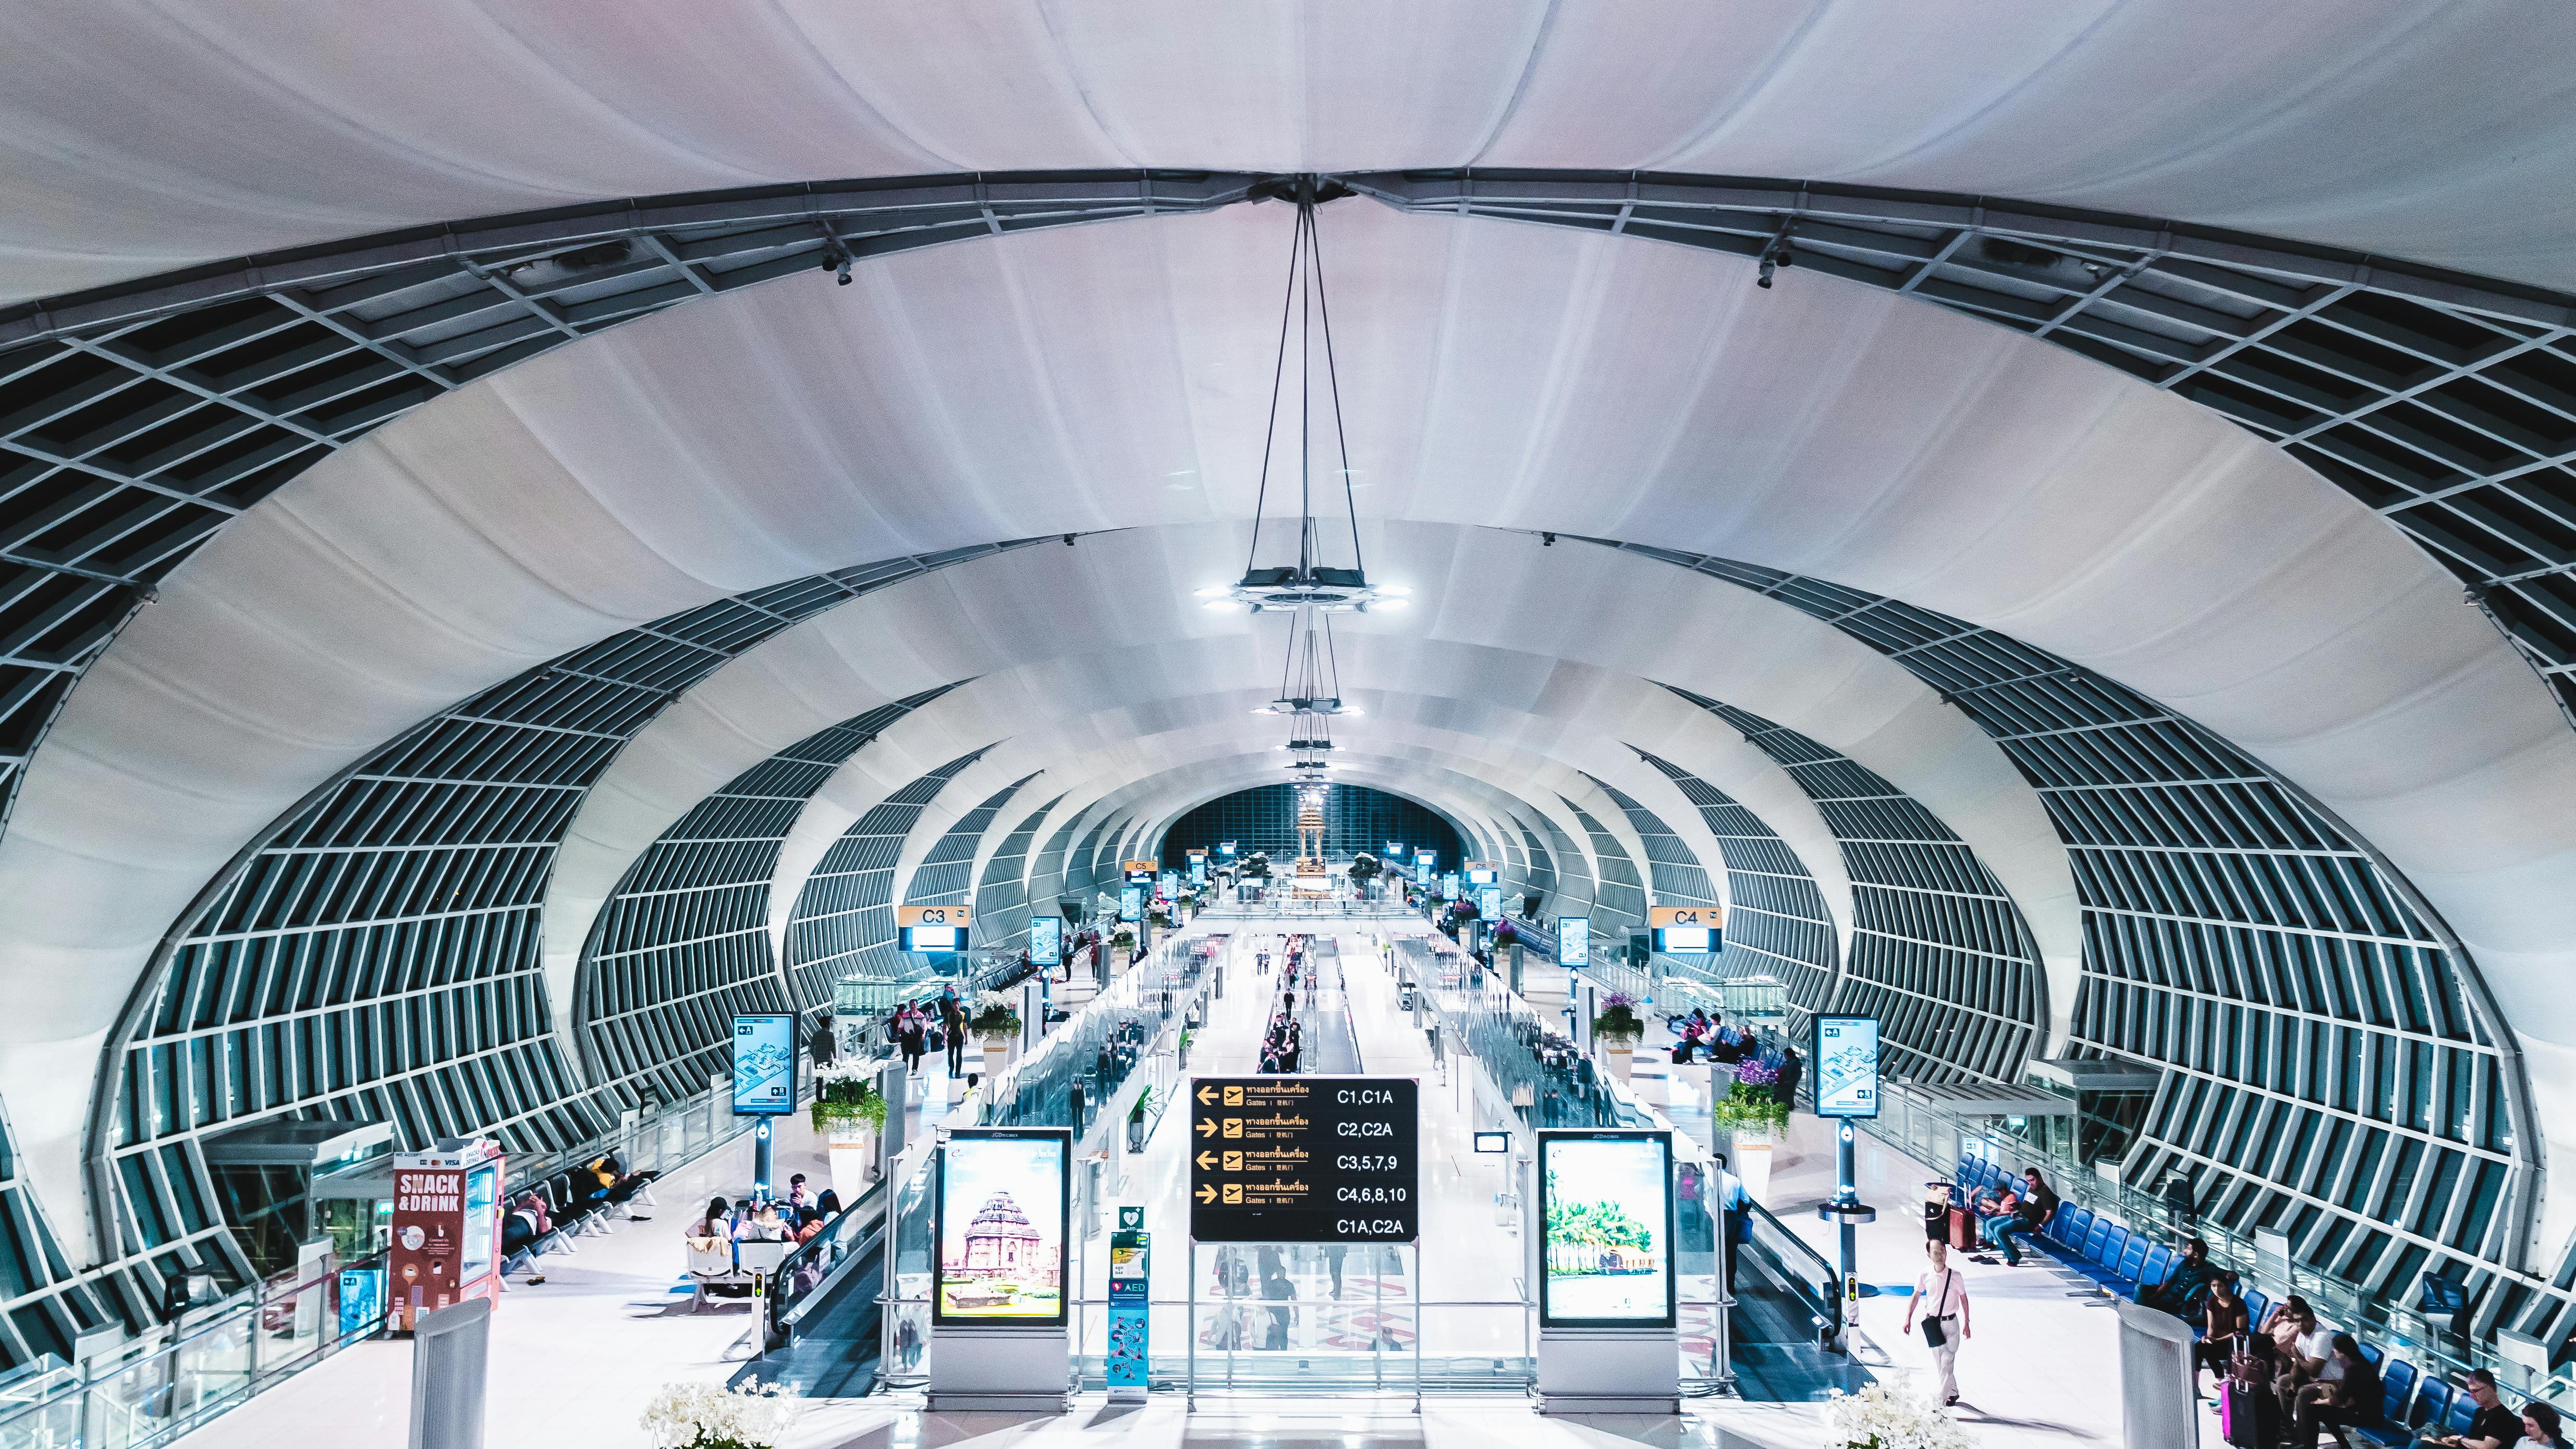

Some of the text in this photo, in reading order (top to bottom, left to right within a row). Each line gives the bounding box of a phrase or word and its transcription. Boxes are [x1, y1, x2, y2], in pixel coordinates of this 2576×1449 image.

[923, 909, 945, 923] C3
[1675, 911, 1698, 924] C4
[1246, 1080, 1309, 1093] ทางออกขึ้นเครื่อง
[1337, 1090, 1393, 1106] C1,C1A
[1246, 1112, 1309, 1125] ทางออกขึ้นเครื่อง
[1337, 1123, 1393, 1138] C2,C2A
[1246, 1145, 1309, 1158] ทางออกขึ้นเครื่อง
[1337, 1156, 1397, 1171] C3,5,7,9
[400, 1174, 459, 1194] SNACK
[1246, 1178, 1309, 1191] ทางออกขึ้นเครื่อง
[398, 1195, 459, 1212] &DRINK
[1337, 1188, 1406, 1204] C4,6,8,10
[1337, 1220, 1404, 1236] C1A,C2A
